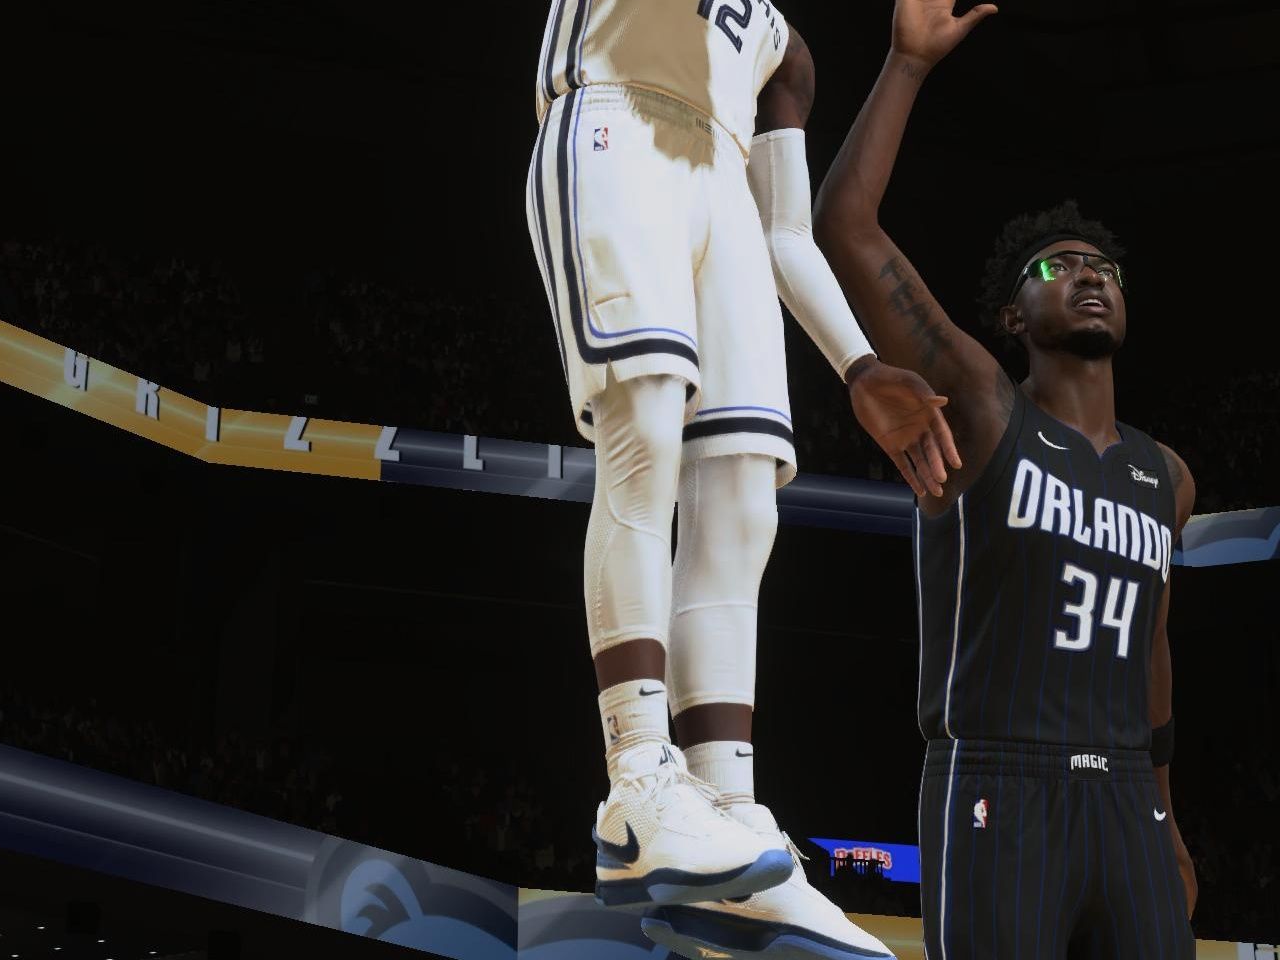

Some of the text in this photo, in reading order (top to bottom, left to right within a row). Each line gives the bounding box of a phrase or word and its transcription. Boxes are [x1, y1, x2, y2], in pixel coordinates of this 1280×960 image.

[1128, 464, 1160, 489] Disney
[1007, 458, 1172, 584] ORLANDO
[1053, 562, 1141, 659] 34
[1071, 754, 1109, 772] MAGIC
